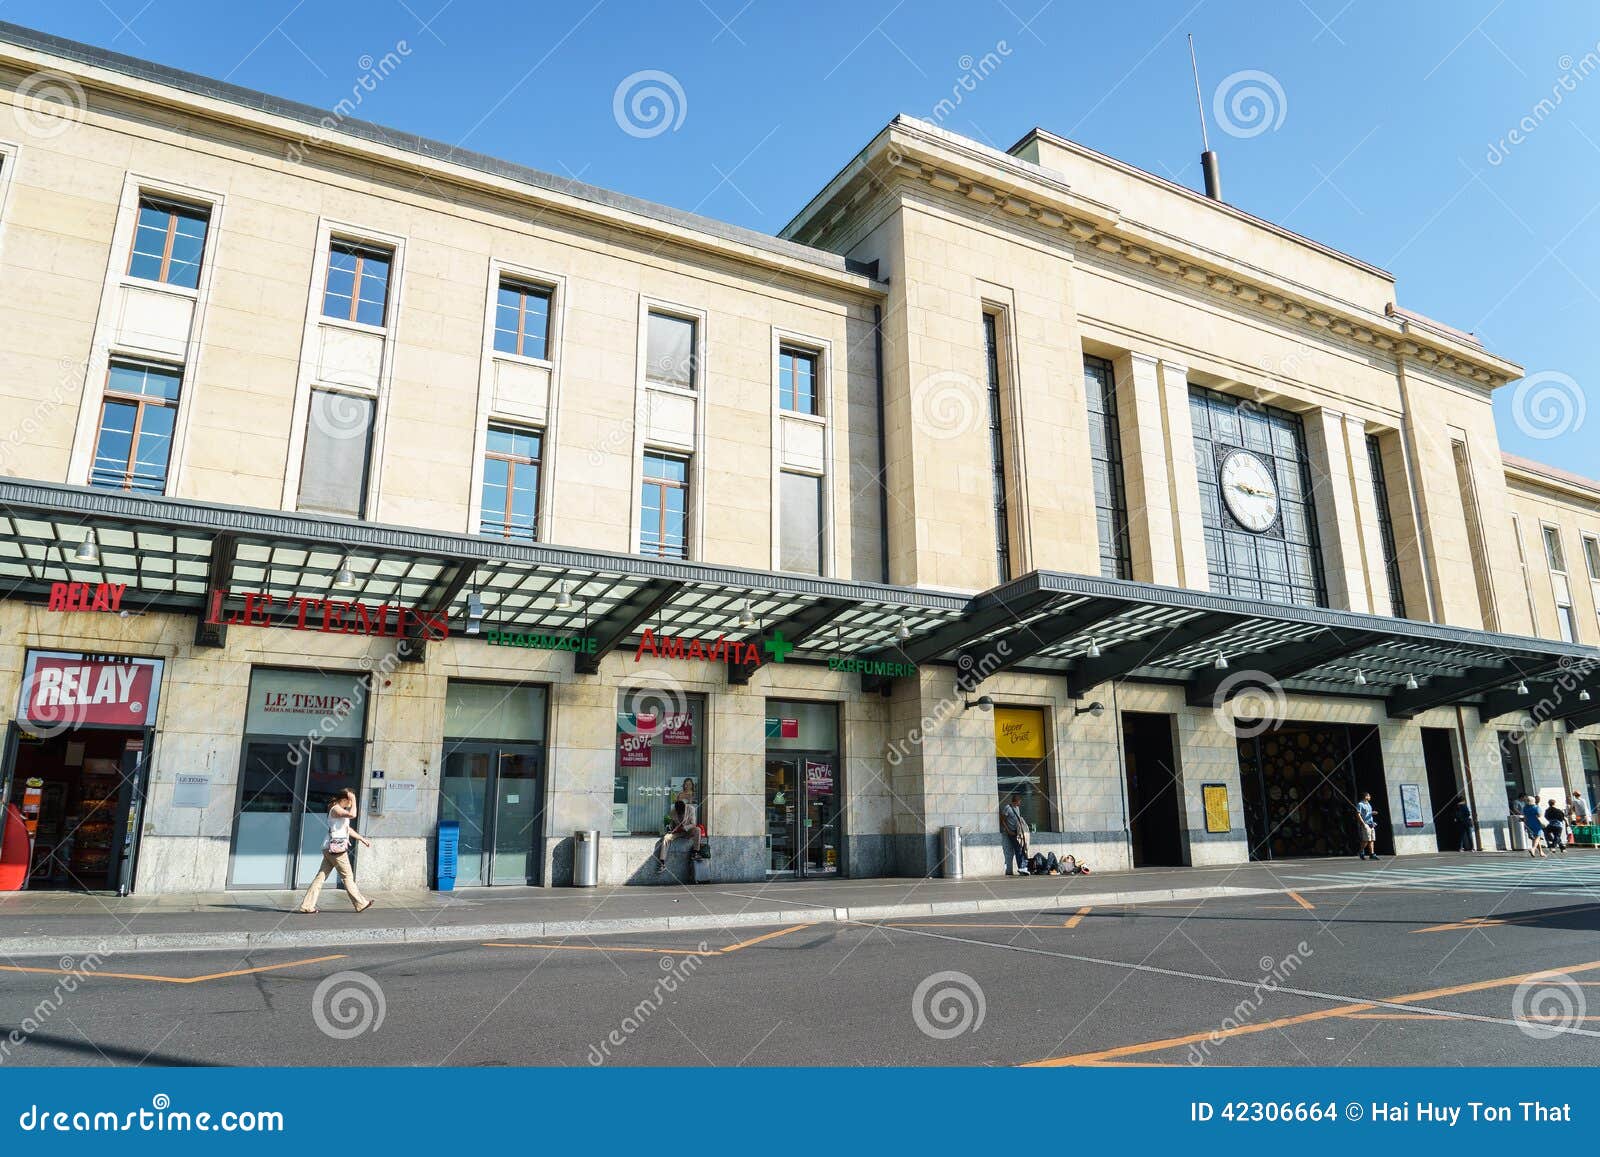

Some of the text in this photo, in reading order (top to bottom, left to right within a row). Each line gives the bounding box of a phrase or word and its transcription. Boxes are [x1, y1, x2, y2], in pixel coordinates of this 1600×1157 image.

[48, 583, 127, 612] RELAY
[204, 590, 449, 642] LE TEMPS
[487, 630, 598, 655] PHARMACIE
[36, 666, 139, 706] RELAY
[264, 692, 351, 709] LE TEMPS
[620, 734, 653, 752] -50%
